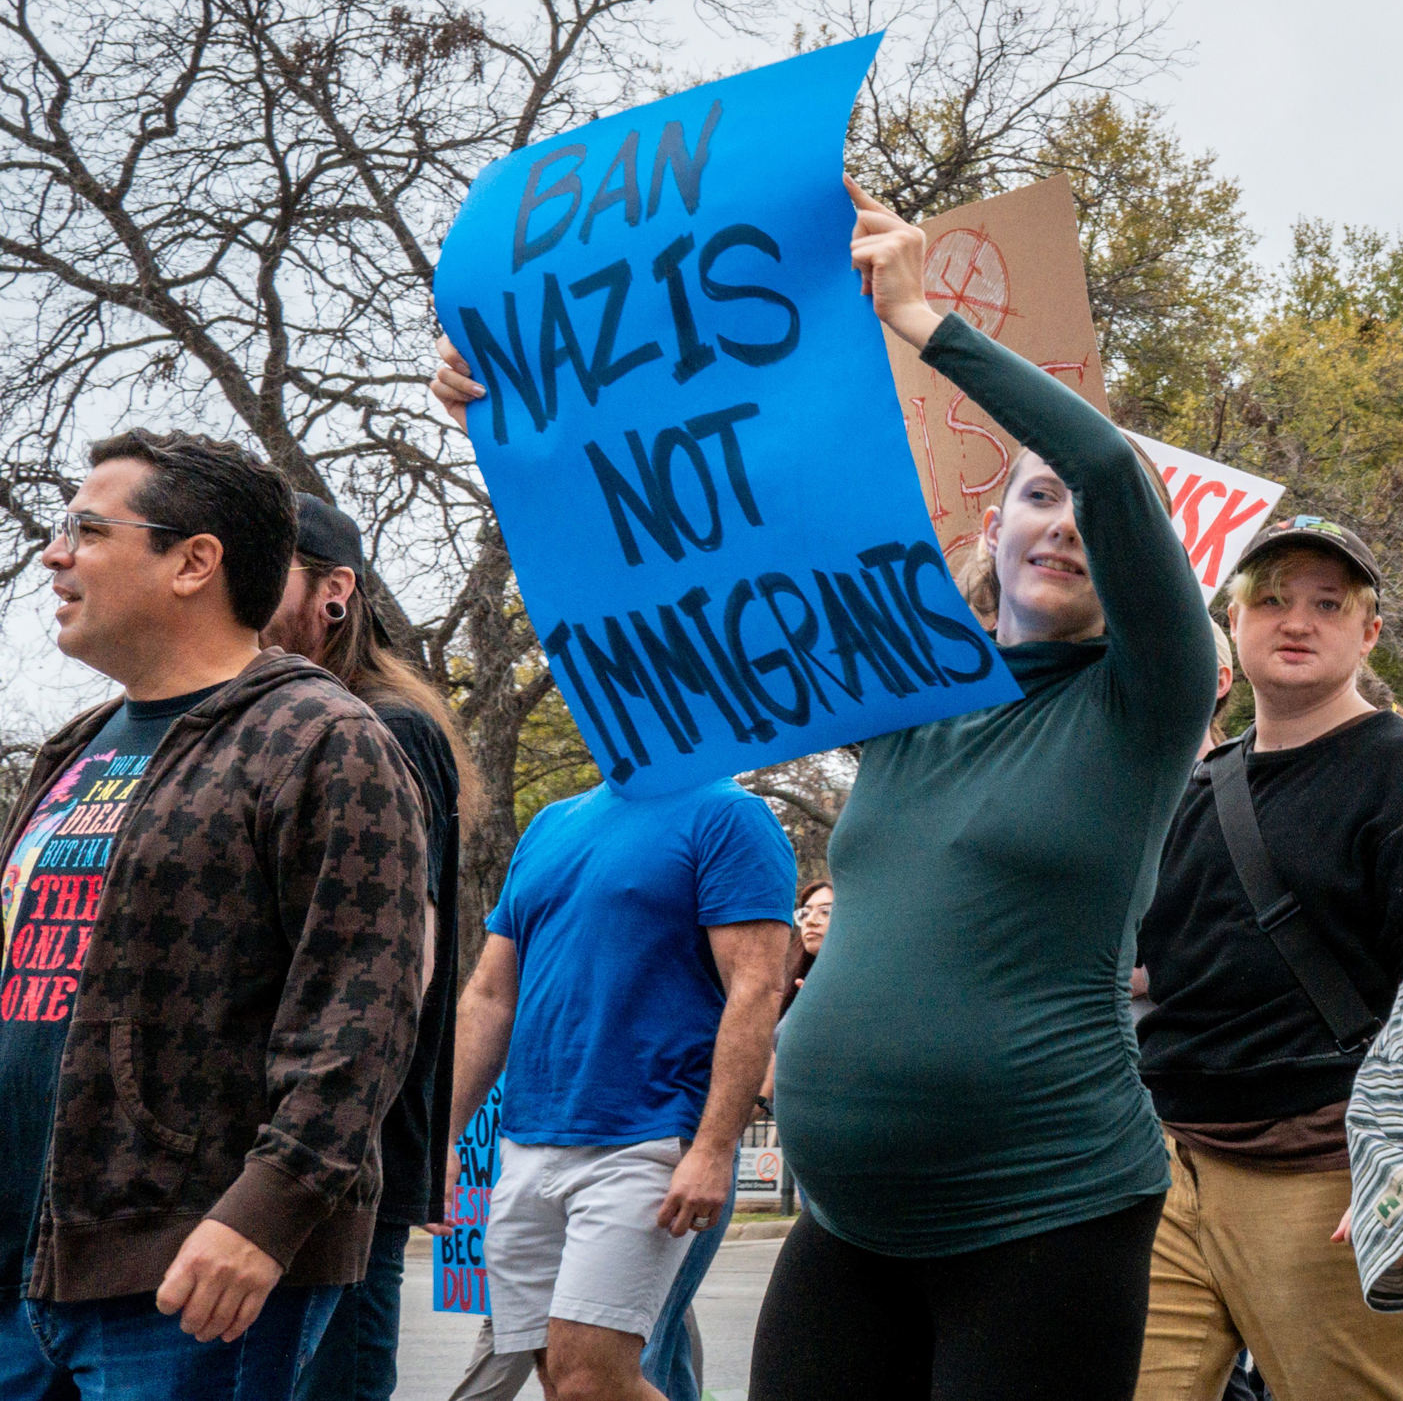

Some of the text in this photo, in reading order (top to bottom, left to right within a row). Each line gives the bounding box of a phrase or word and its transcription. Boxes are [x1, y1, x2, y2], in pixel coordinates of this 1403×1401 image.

[512, 99, 723, 275] BAN
[459, 223, 800, 445] NAZIS
[584, 402, 765, 567] NOT
[1153, 463, 1269, 587] USK
[544, 540, 993, 785] IMMIGRANTS
[103, 754, 137, 777] YOU
[38, 838, 79, 868] BUT
[1, 974, 78, 1023] ONE
